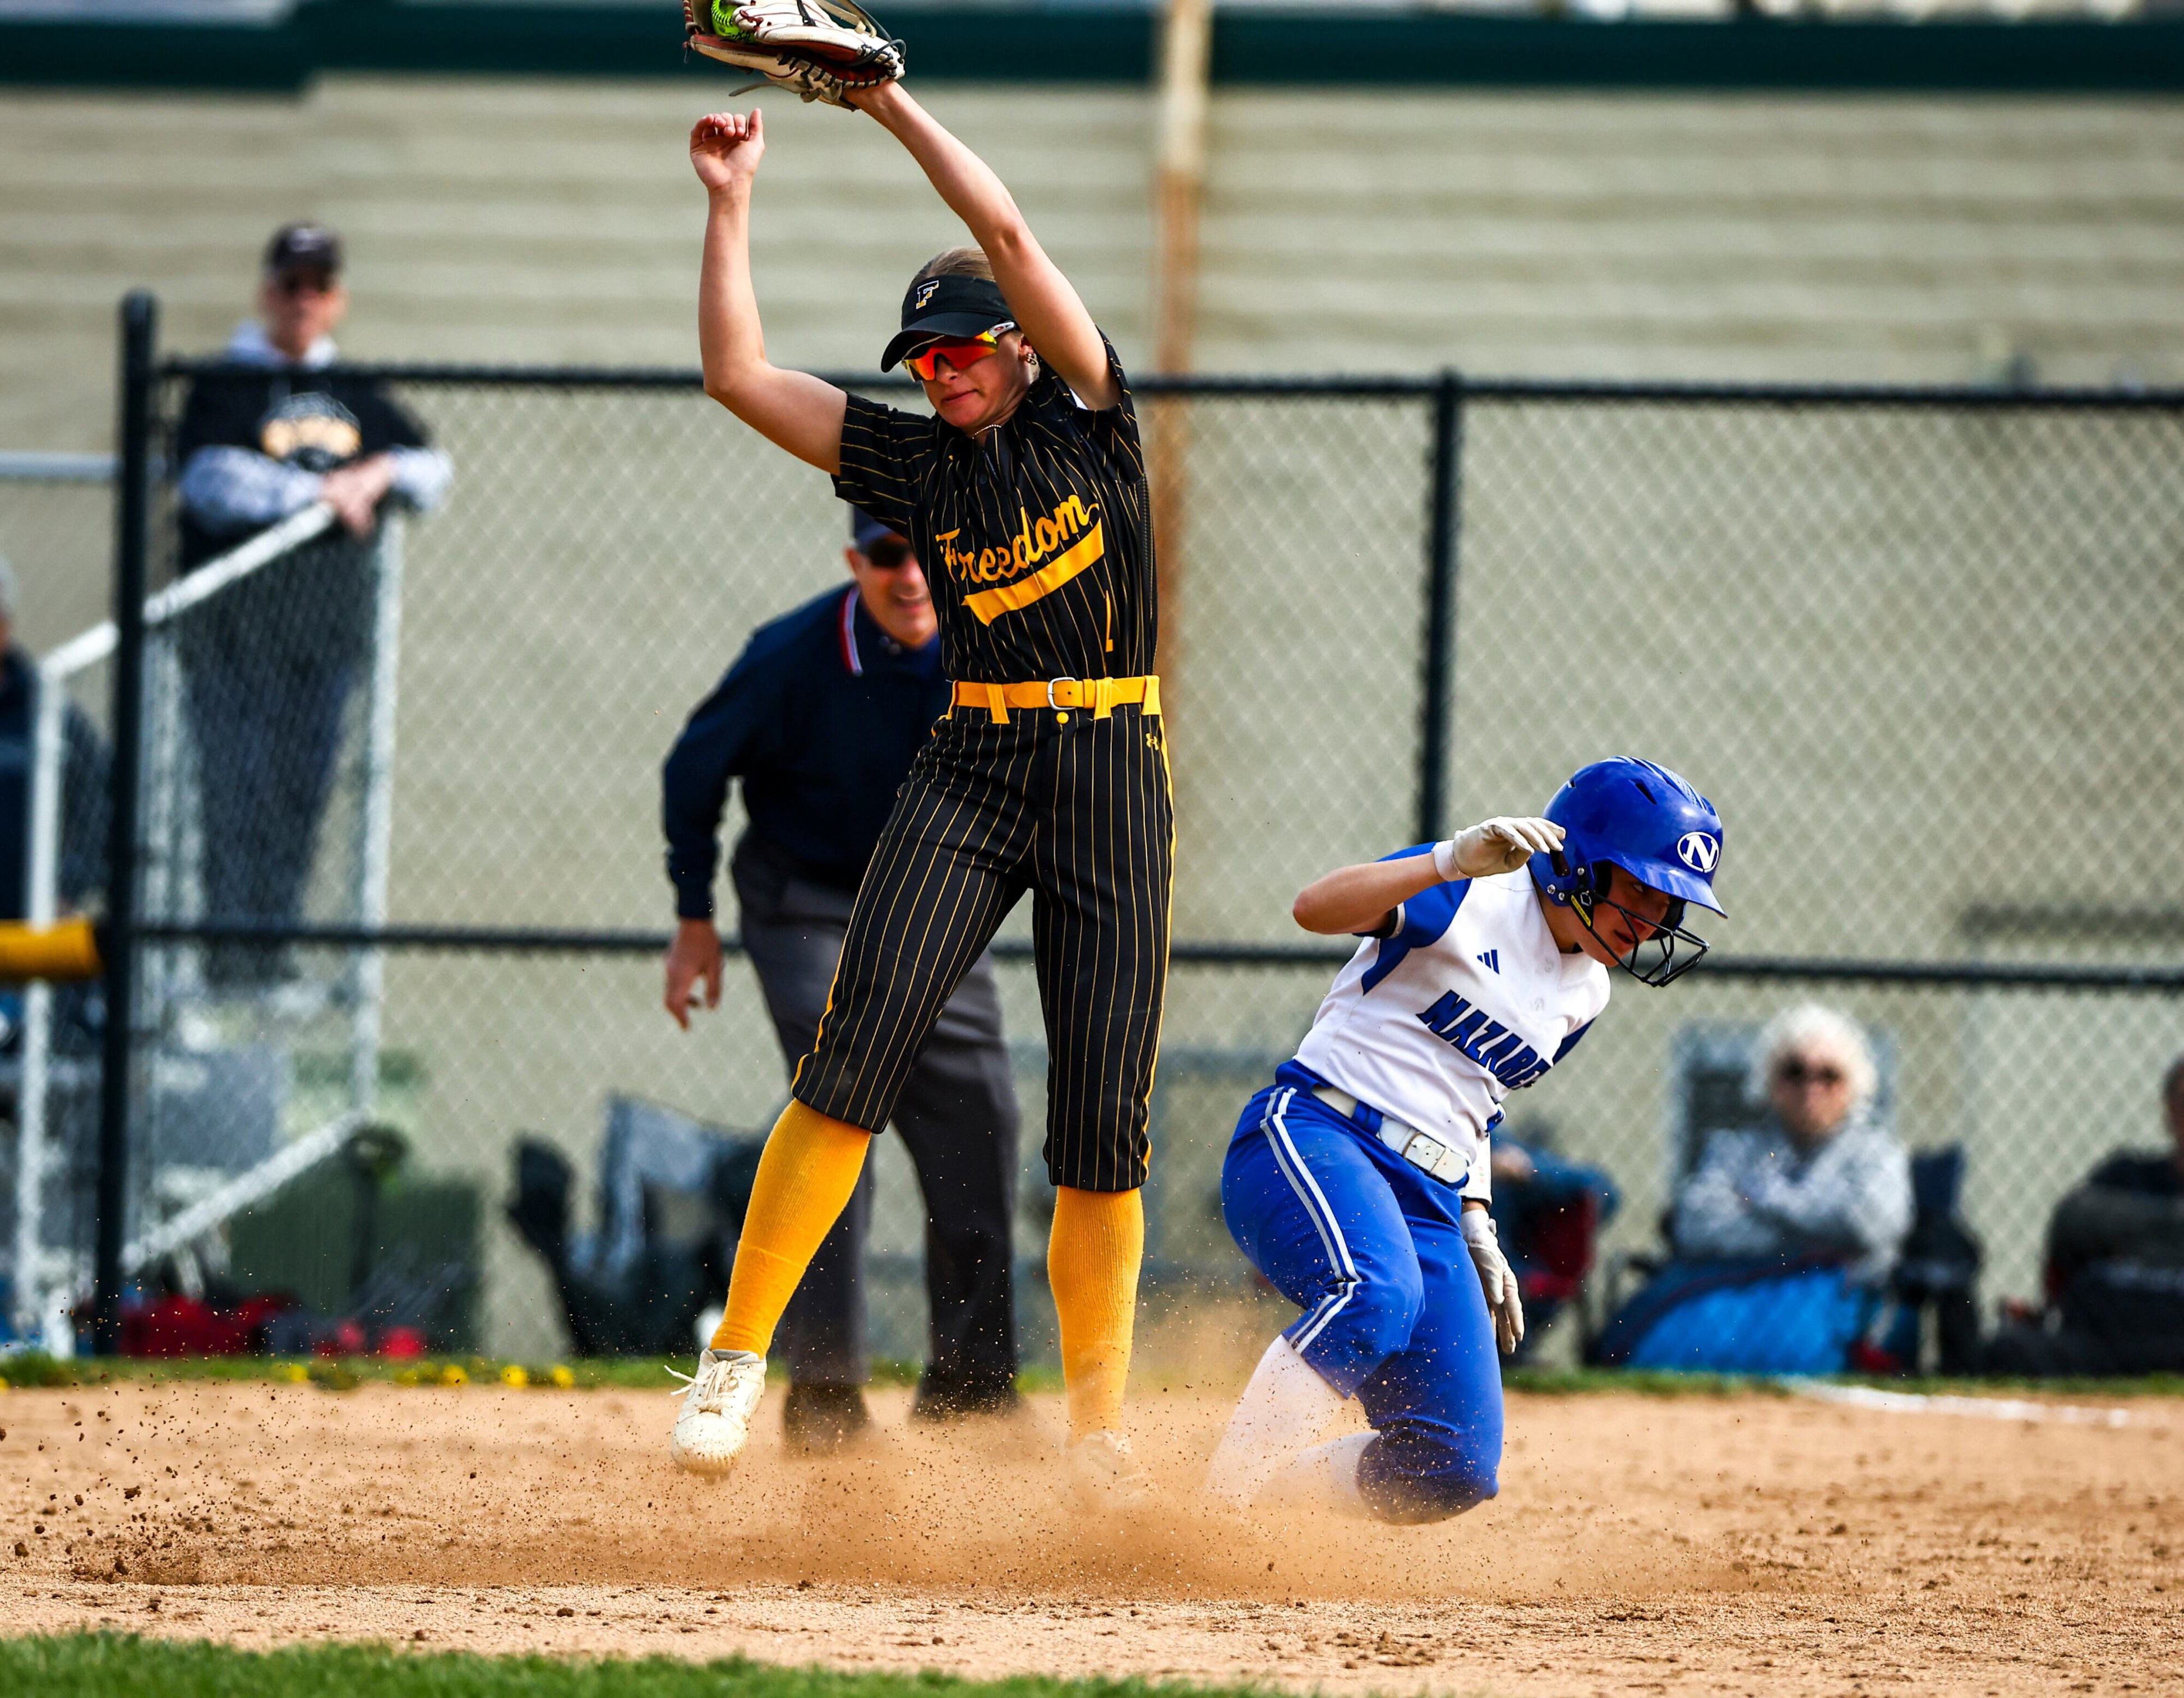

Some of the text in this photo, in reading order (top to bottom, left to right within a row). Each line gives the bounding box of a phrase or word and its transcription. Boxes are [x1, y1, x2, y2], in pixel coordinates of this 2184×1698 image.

[916, 280, 939, 309] F
[935, 494, 1100, 584] Freedom
[1683, 834, 1717, 870] N
